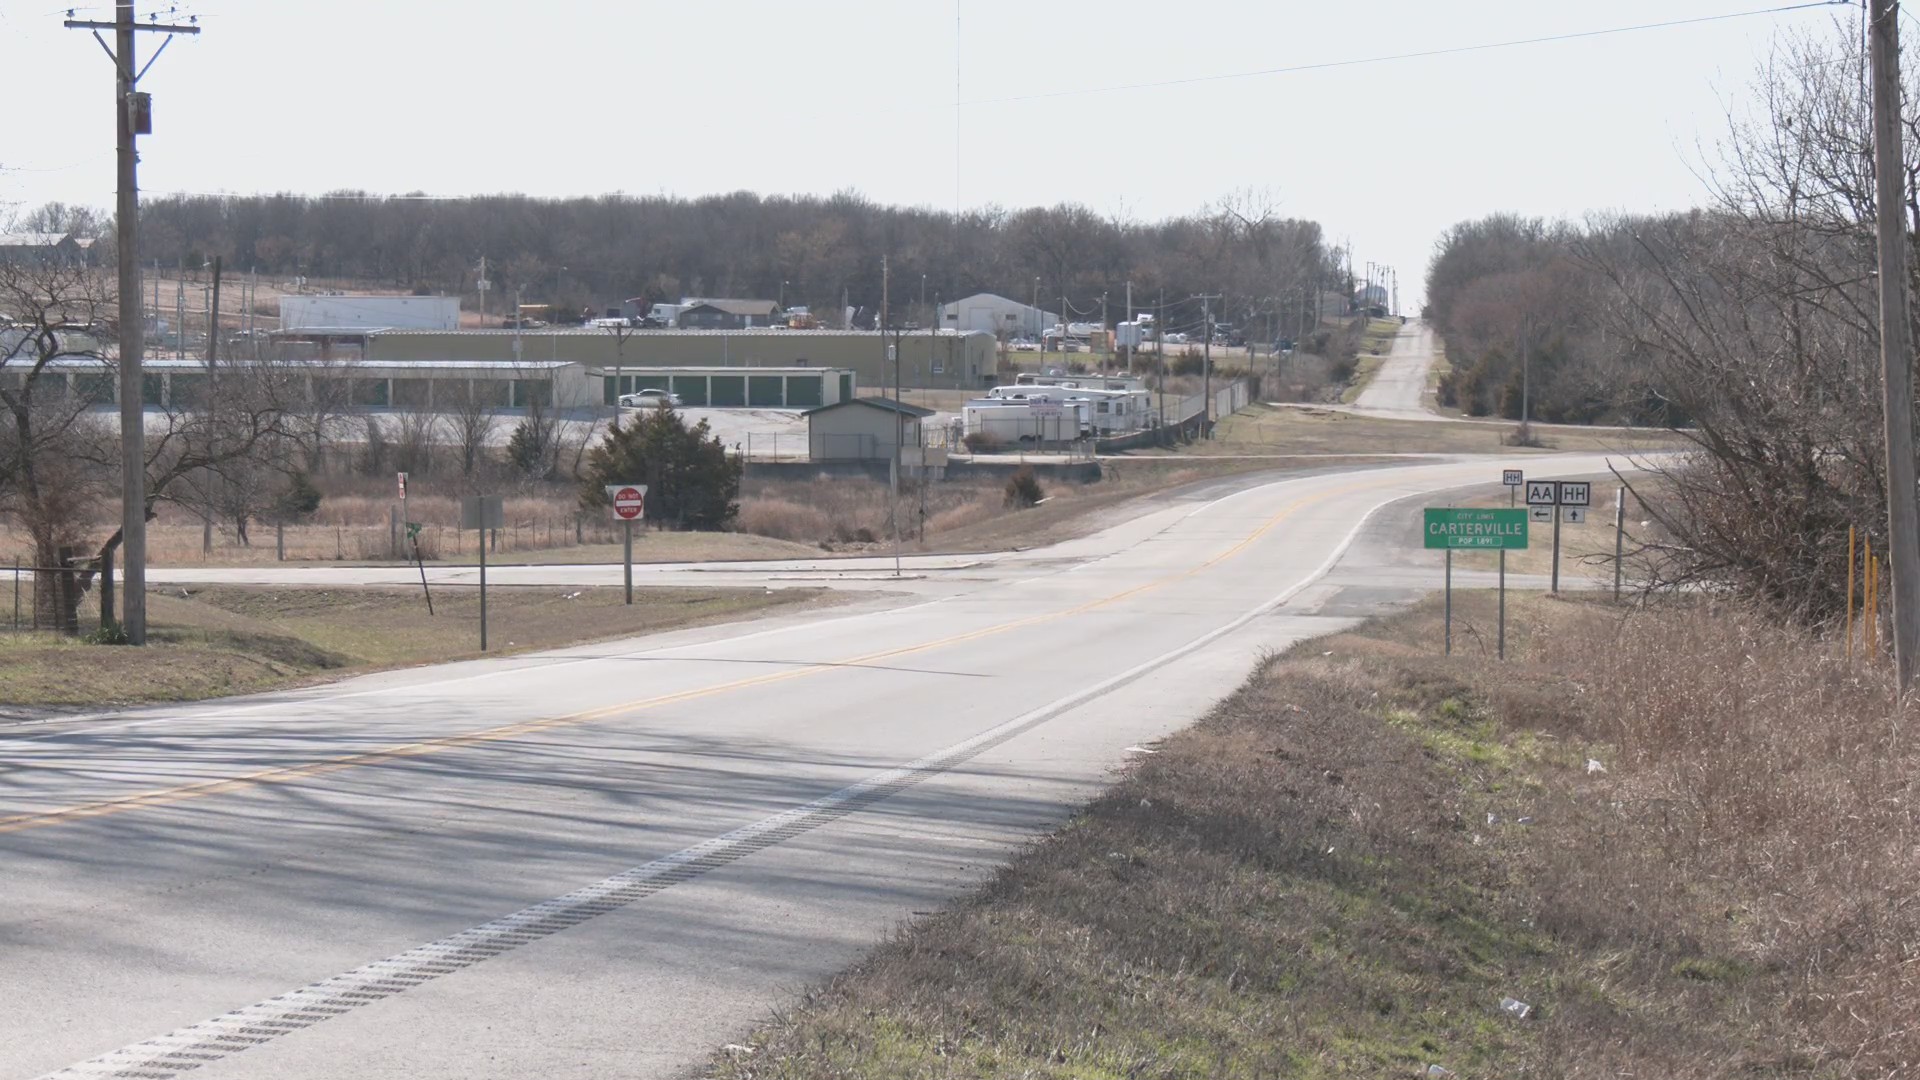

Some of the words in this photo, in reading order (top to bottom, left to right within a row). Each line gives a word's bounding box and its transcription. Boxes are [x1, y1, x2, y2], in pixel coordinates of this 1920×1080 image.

[1506, 473, 1520, 482] HH
[1530, 487, 1552, 500] AA
[1564, 487, 1585, 500] HH
[1430, 523, 1522, 536] CARTERVILLE
